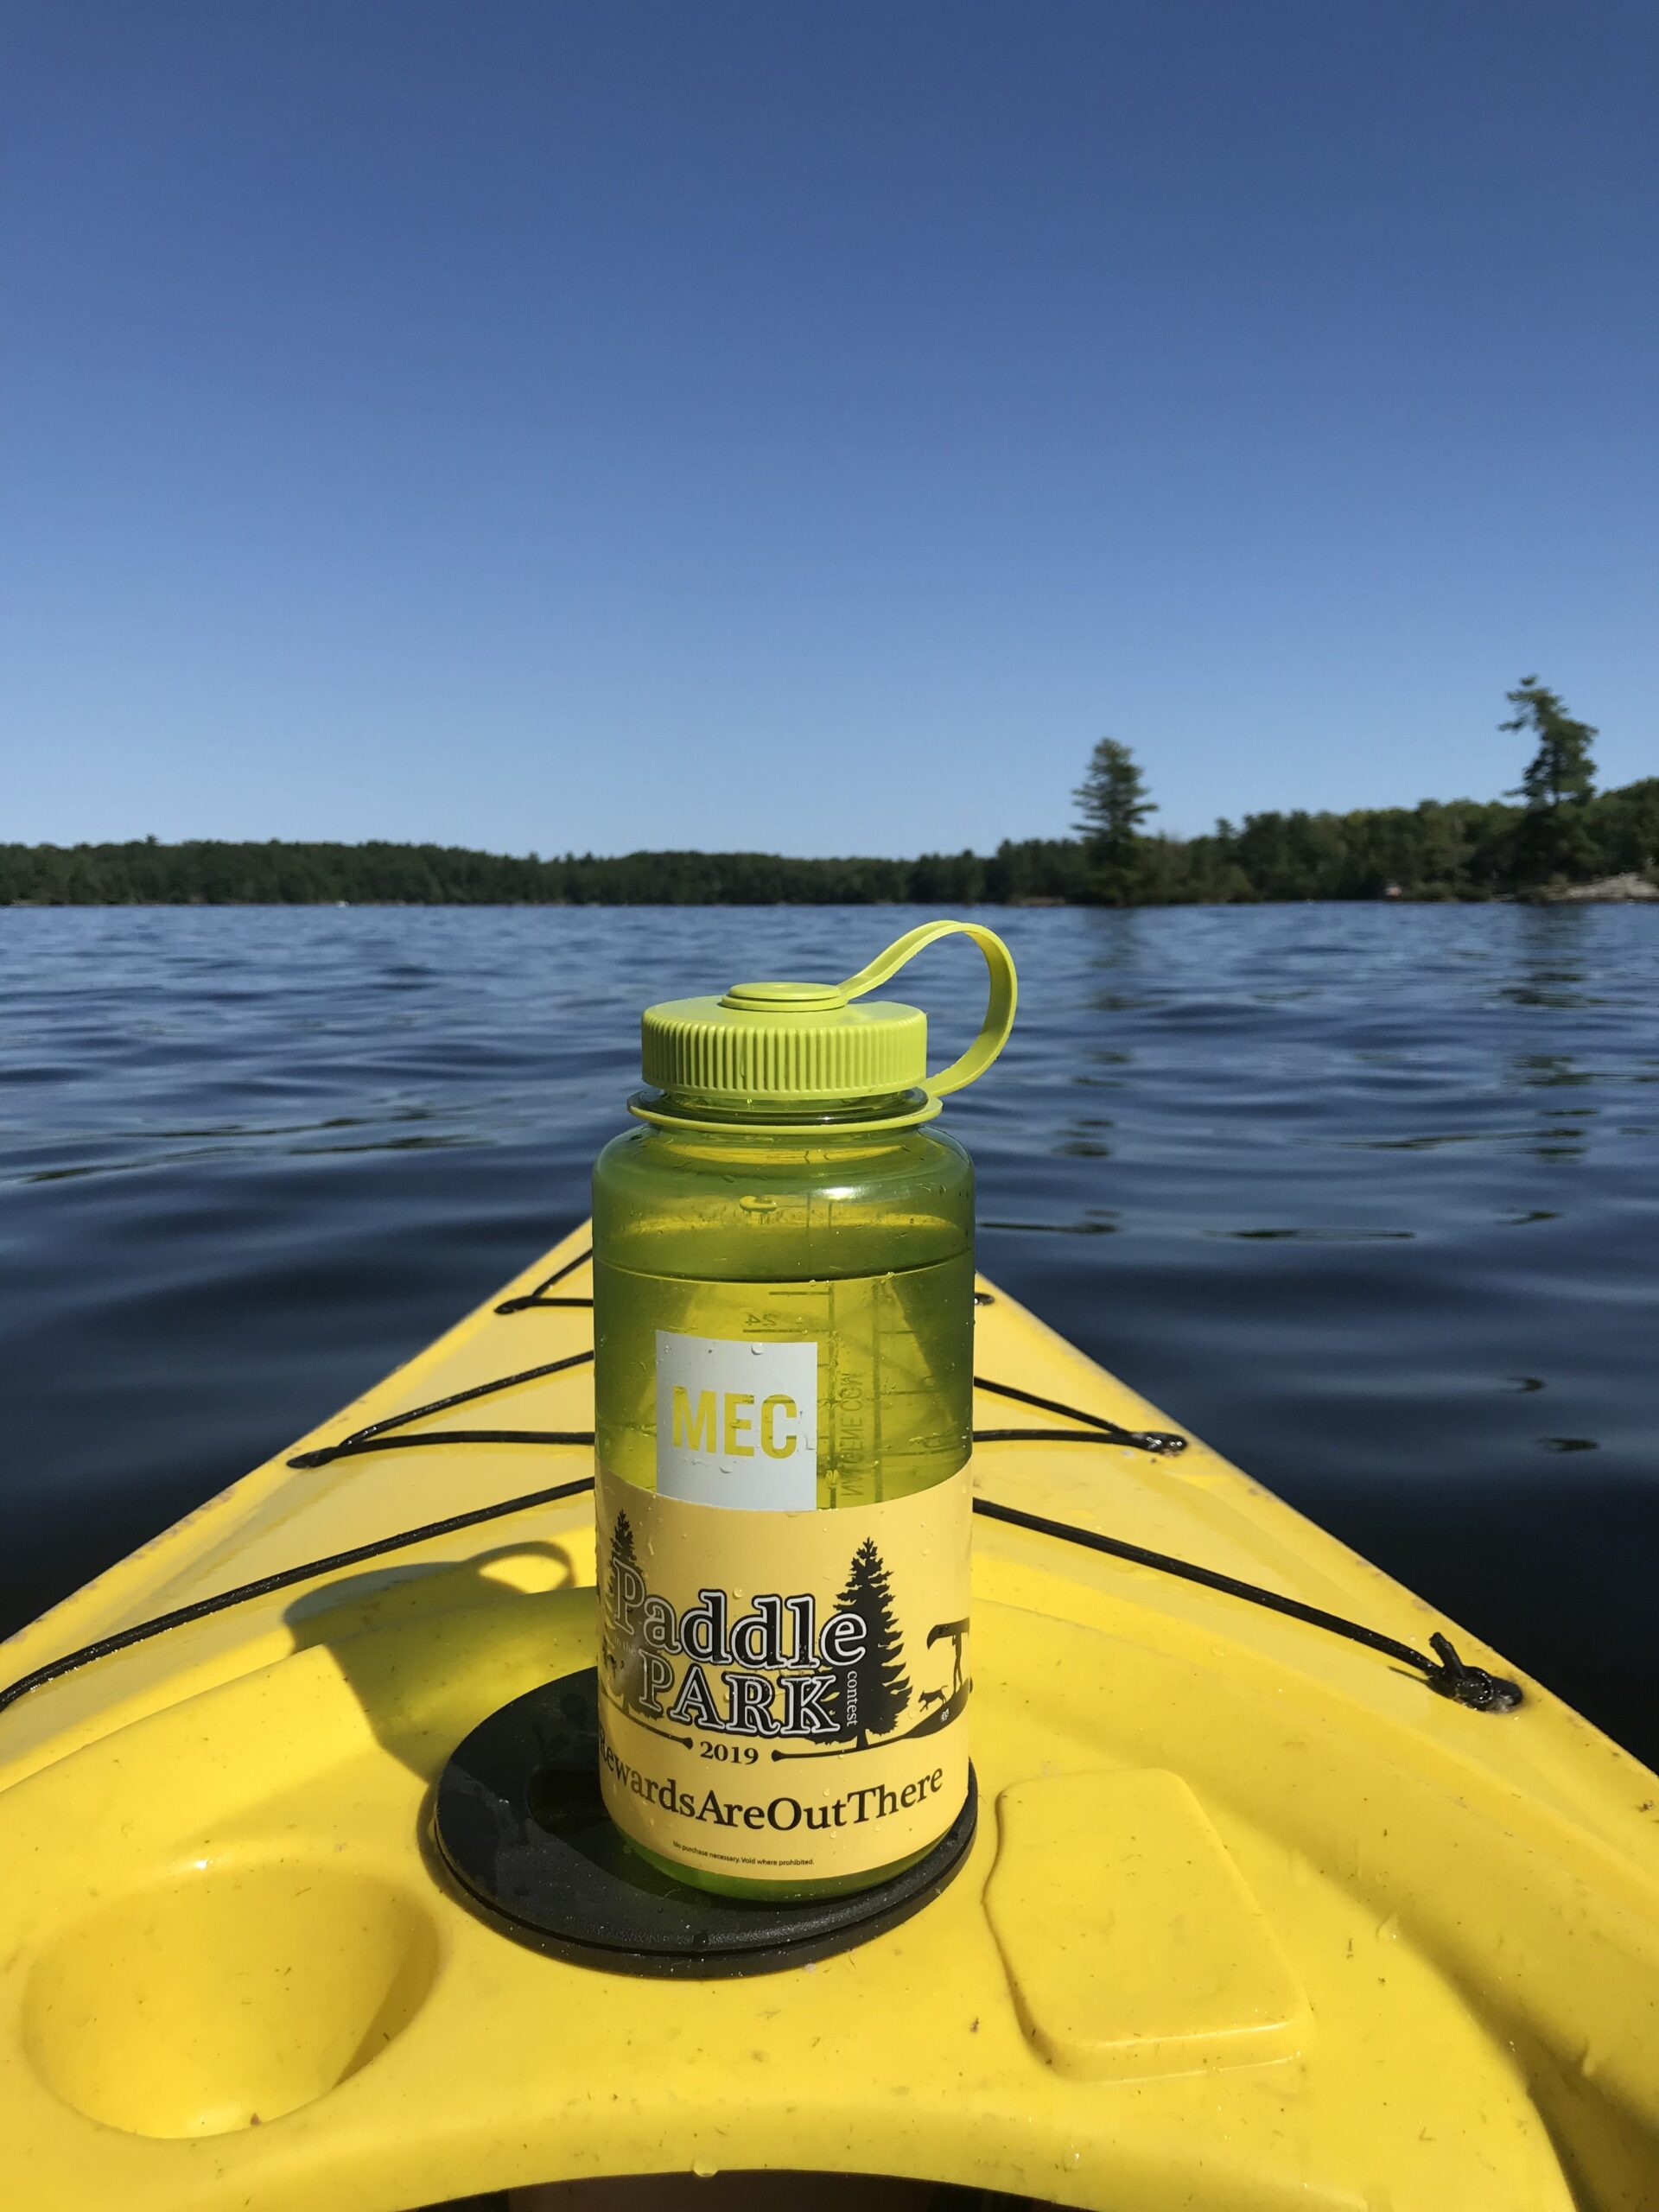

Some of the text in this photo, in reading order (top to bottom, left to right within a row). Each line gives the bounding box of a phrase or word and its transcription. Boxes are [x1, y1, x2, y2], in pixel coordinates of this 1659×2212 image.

[672, 1385, 798, 1459] MEC
[610, 1556, 868, 1670] Paddle
[638, 1648, 842, 1736] PARK
[846, 1669, 859, 1726] contest
[700, 1740, 759, 1765] 2019
[672, 1840, 682, 1849] No
[682, 1844, 709, 1858] purchase
[709, 1852, 741, 1864] necessary.
[741, 1856, 756, 1865] Void
[779, 1858, 815, 1867] prohibited.
